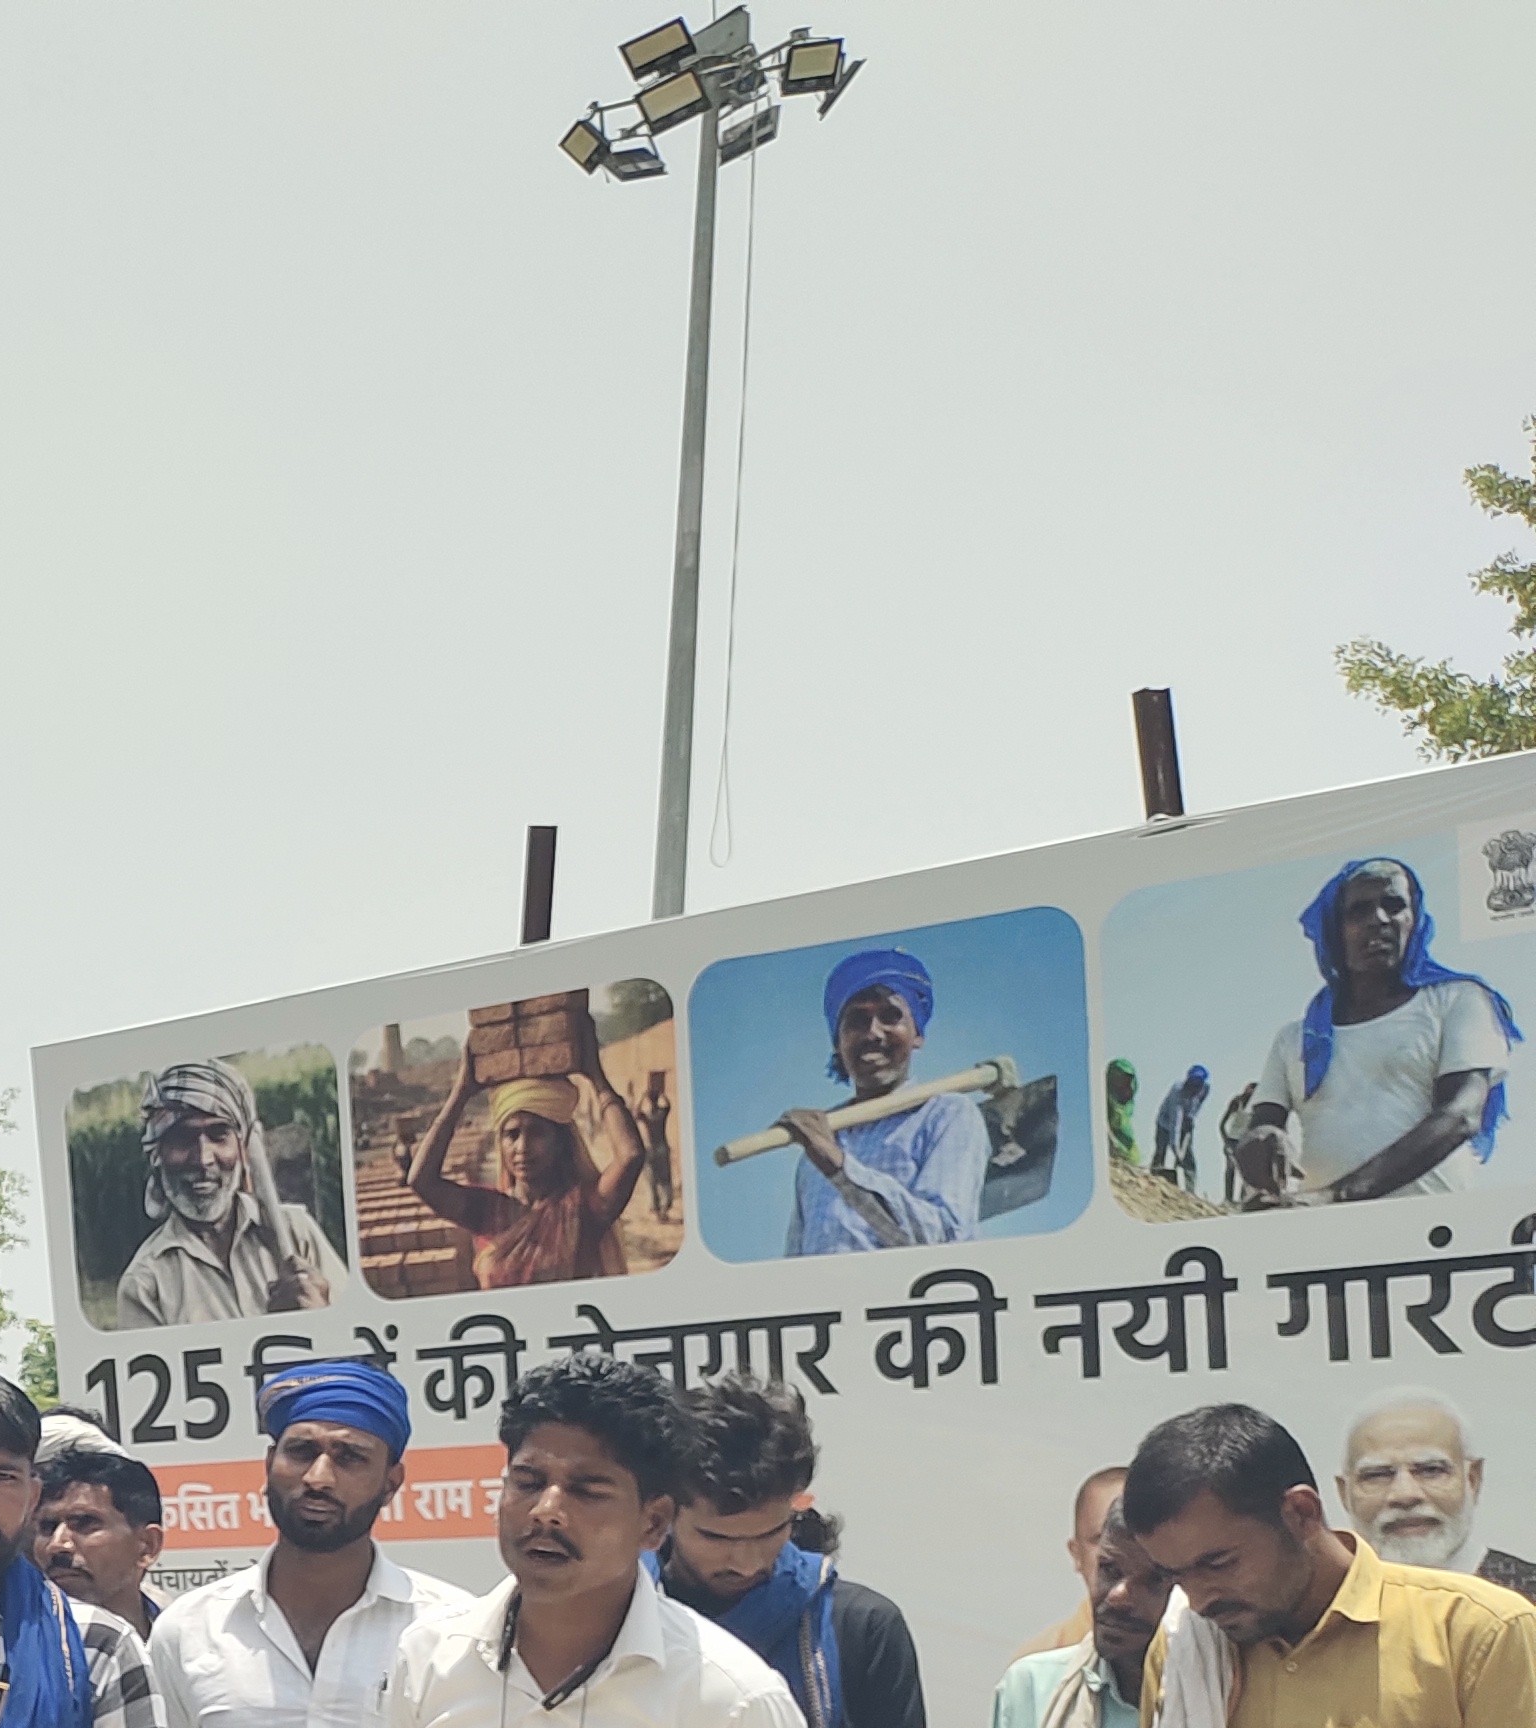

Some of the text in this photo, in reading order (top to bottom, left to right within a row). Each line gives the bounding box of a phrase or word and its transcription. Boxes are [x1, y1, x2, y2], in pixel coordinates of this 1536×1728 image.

[85, 1347, 231, 1445] 125
[416, 1314, 528, 1420] की
[865, 1268, 1008, 1389] की
[1034, 1246, 1238, 1378] नयी
[410, 1480, 473, 1520] राम
